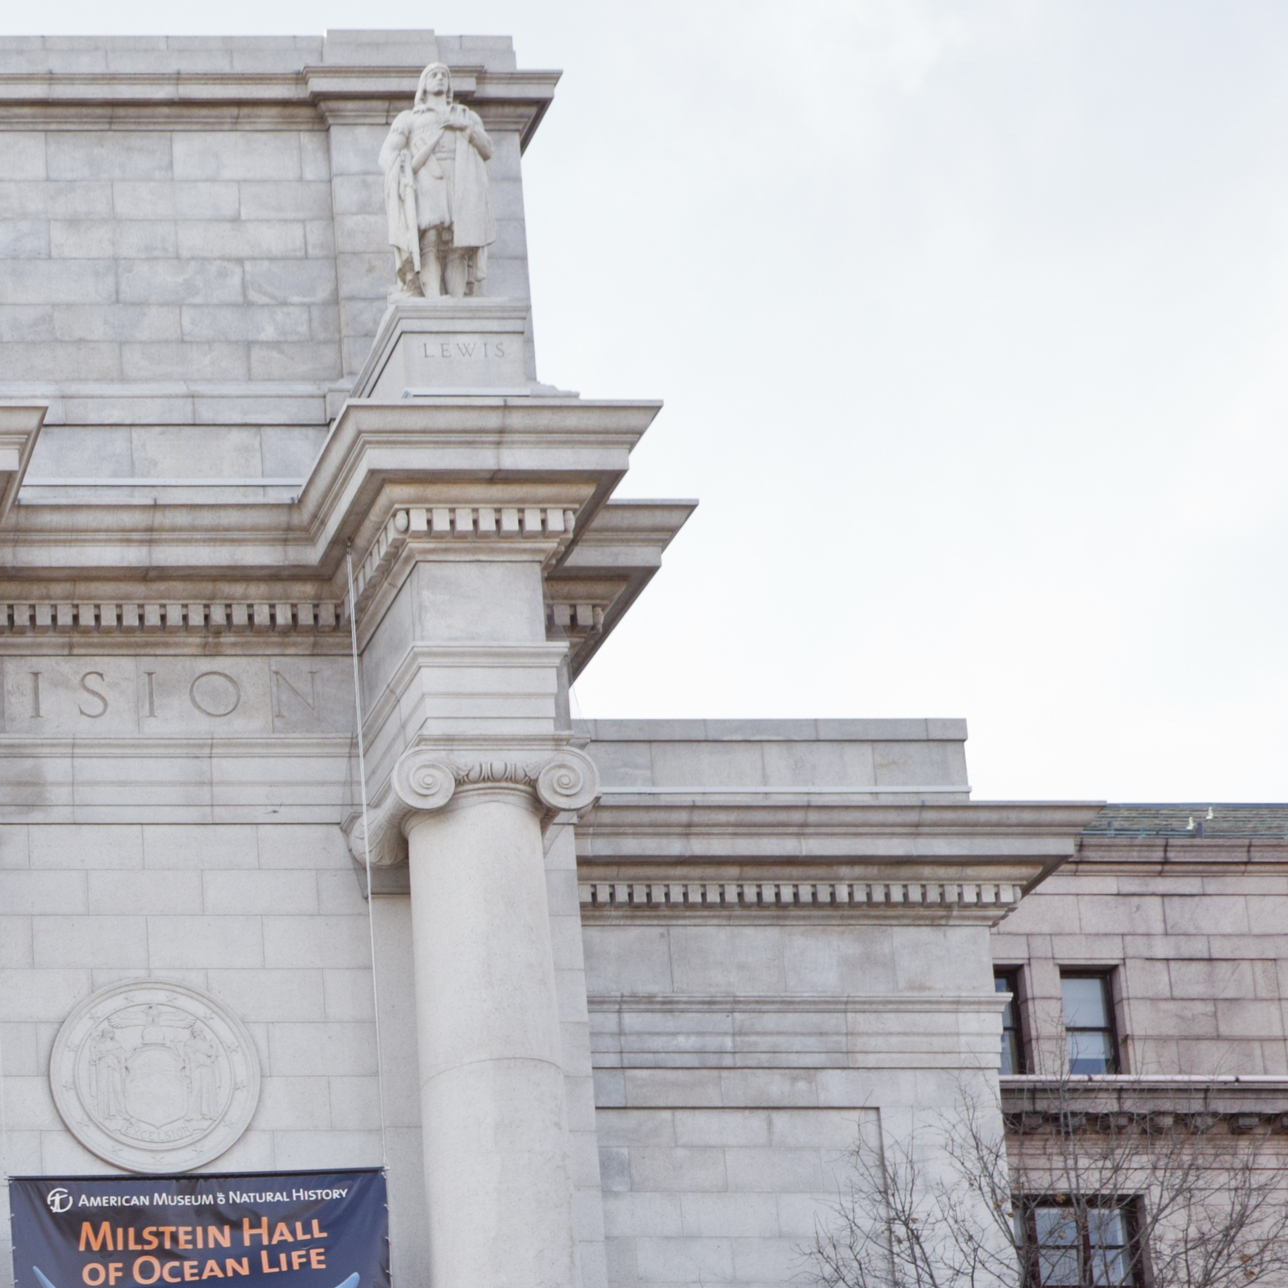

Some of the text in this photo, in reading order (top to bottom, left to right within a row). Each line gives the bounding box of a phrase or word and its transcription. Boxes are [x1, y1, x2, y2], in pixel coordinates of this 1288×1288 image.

[423, 342, 505, 359] LEWIS
[123, 1125, 192, 1141] EXCELSIOR
[78, 1194, 149, 1207] AMERICAN
[153, 1192, 214, 1206] MUSEUM
[229, 1190, 290, 1204] NATURAL
[292, 1188, 348, 1202] HISTORY
[78, 1216, 328, 1252] MILSTEIN HALL
[81, 1248, 326, 1286] OF OCEAN LIFE
